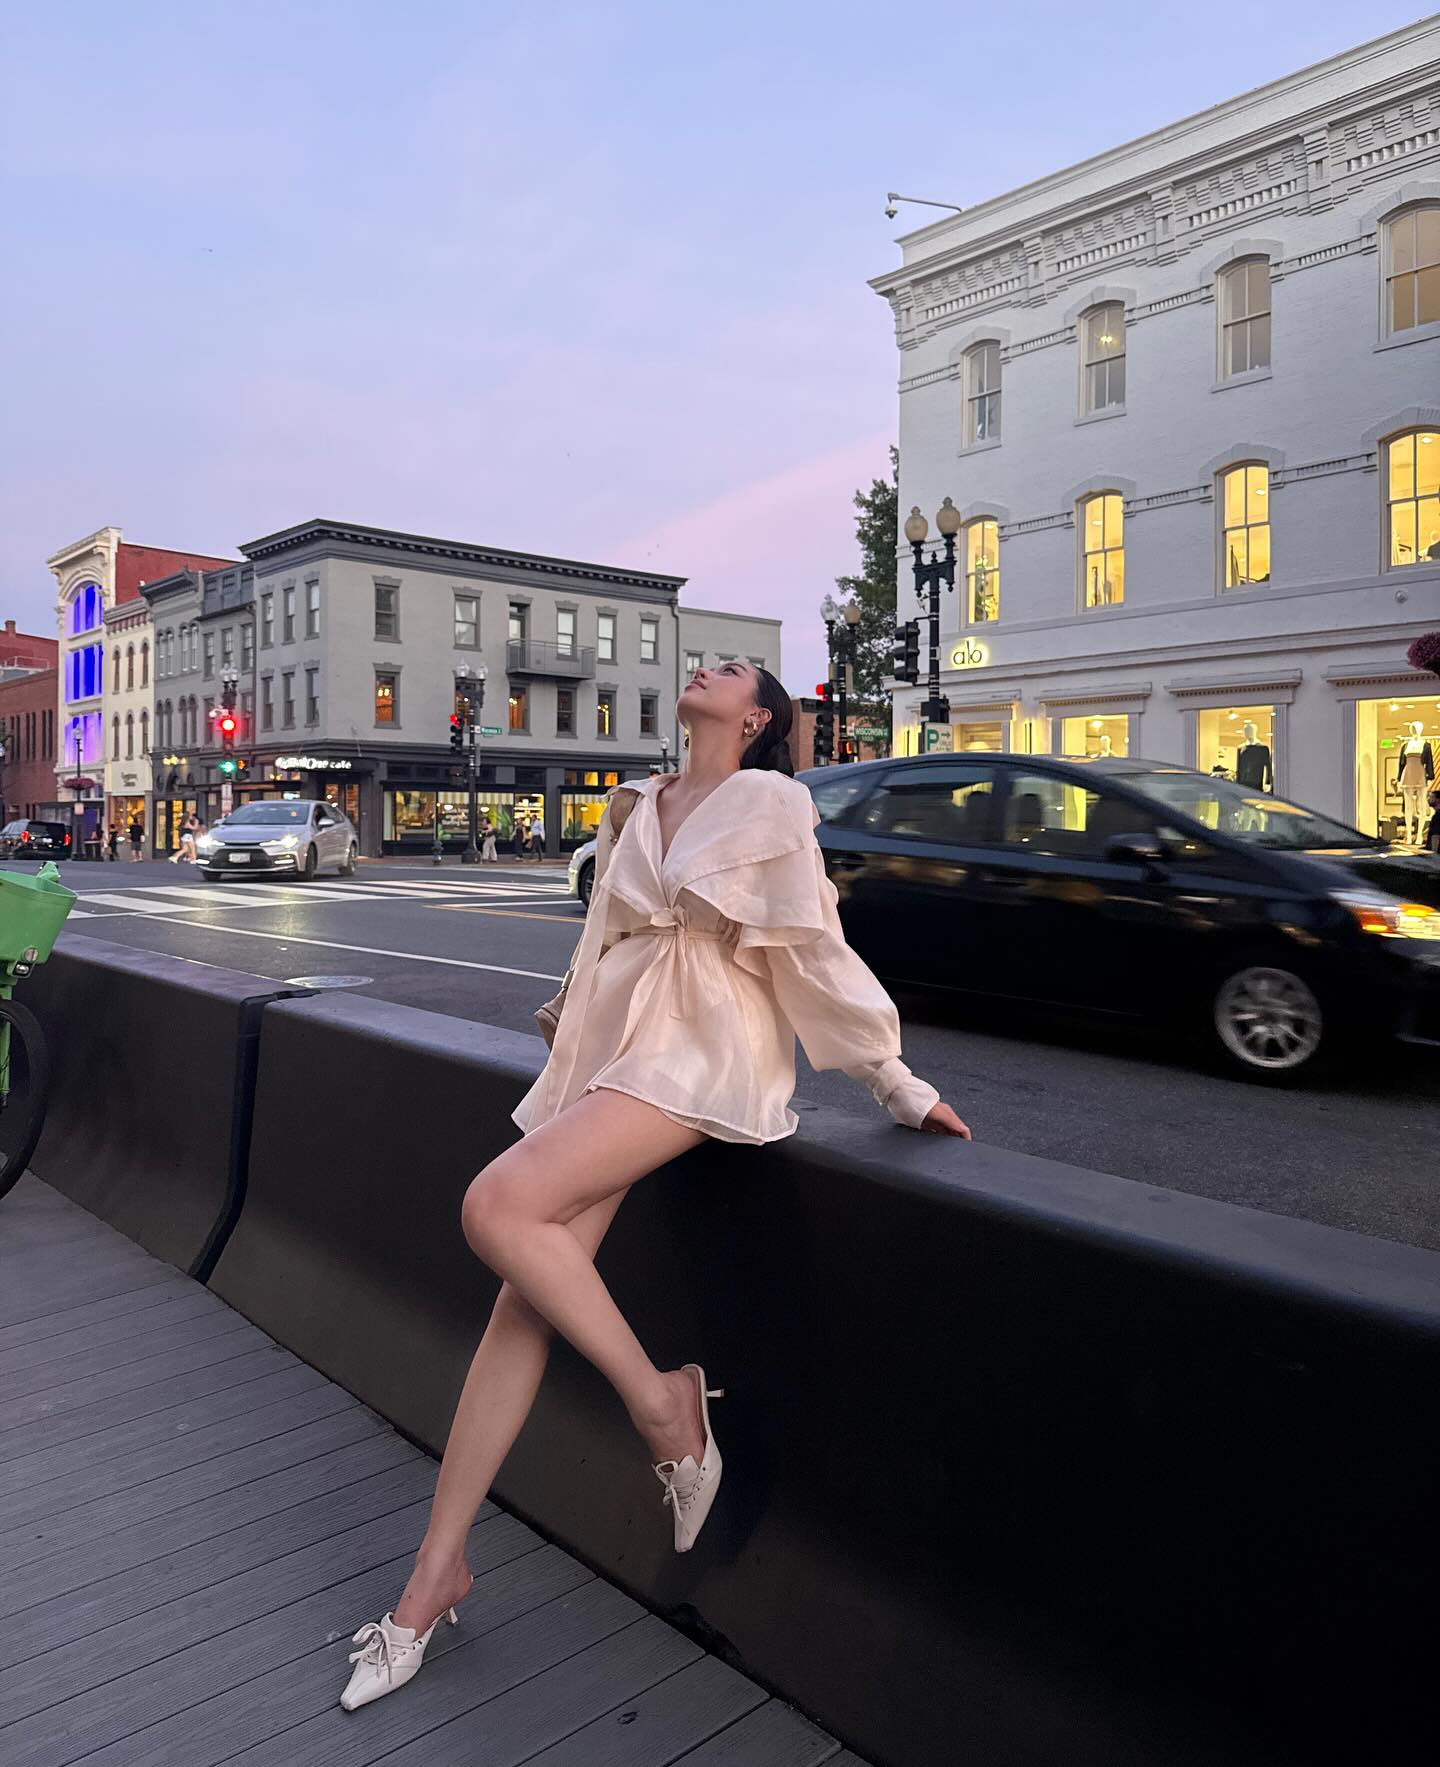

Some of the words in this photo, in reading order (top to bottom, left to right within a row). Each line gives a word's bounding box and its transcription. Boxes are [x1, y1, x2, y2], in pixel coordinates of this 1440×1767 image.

[953, 641, 982, 665] alo
[855, 728, 883, 736] WISCONSIN
[927, 729, 940, 751] P
